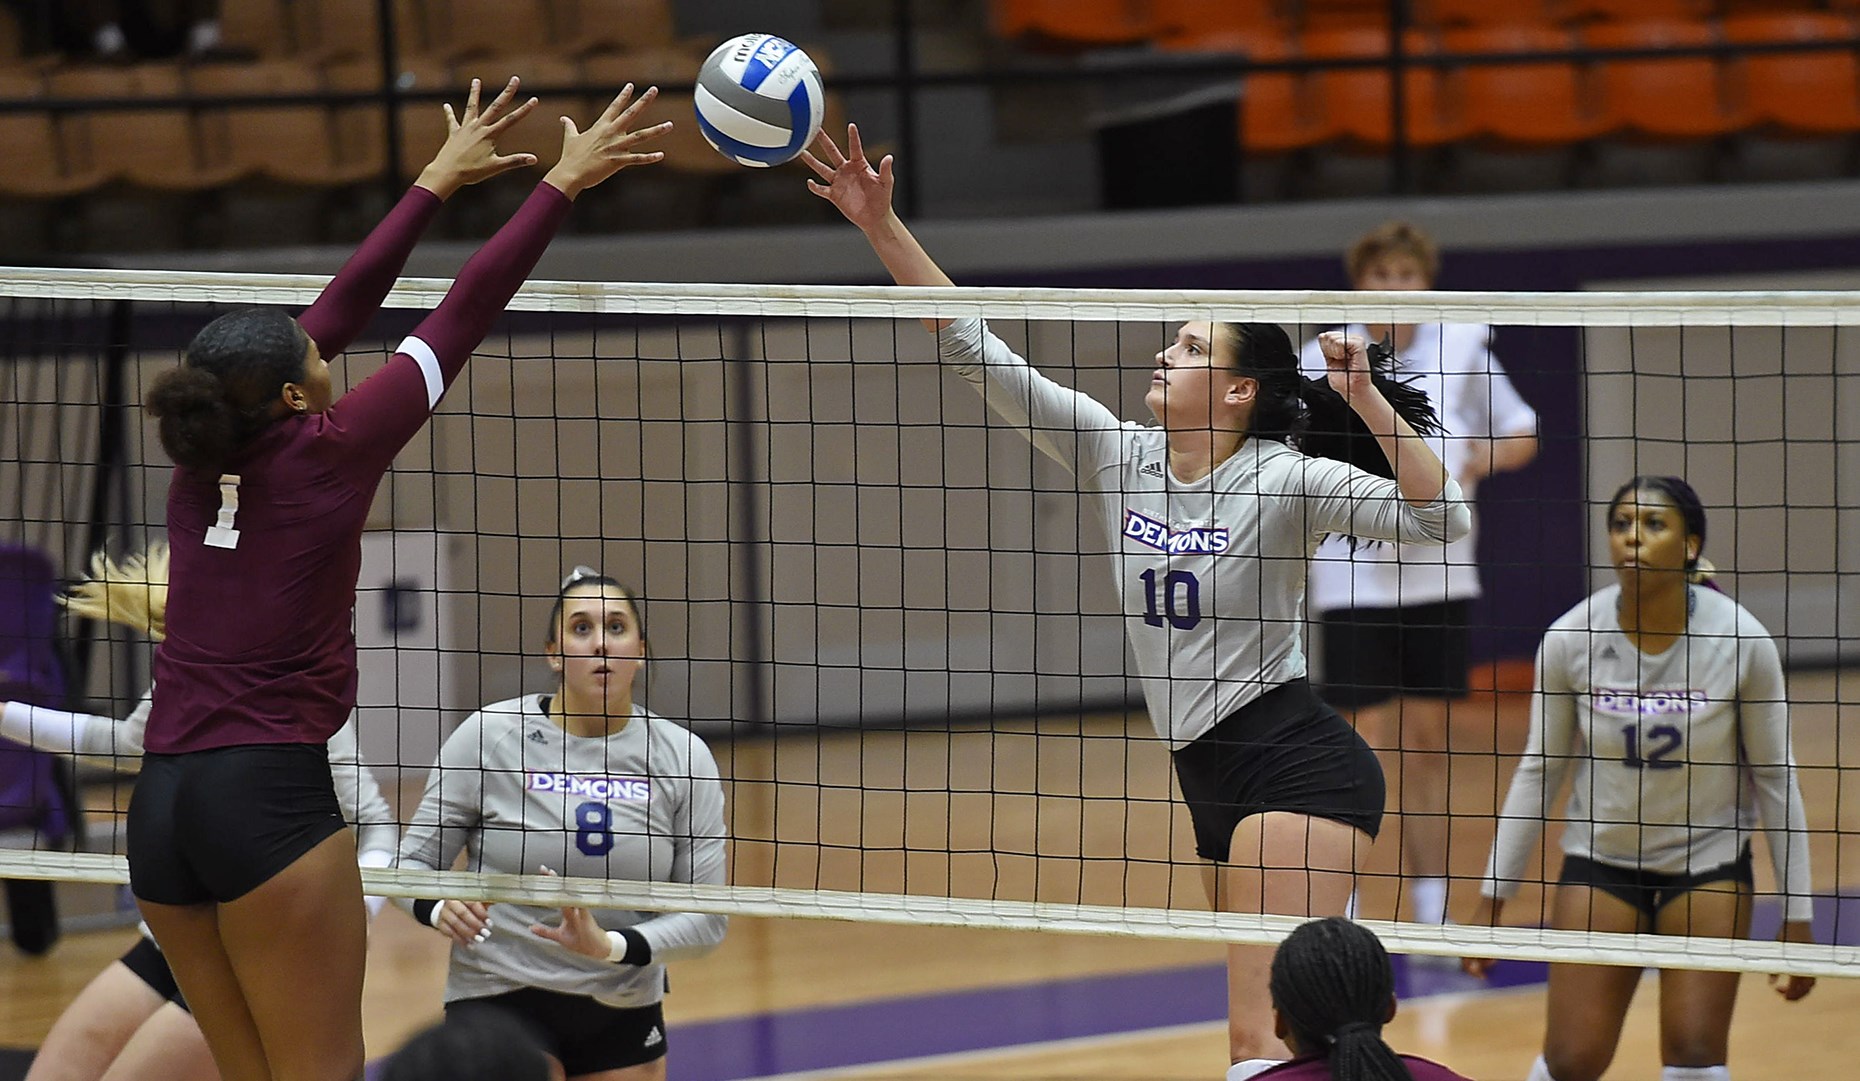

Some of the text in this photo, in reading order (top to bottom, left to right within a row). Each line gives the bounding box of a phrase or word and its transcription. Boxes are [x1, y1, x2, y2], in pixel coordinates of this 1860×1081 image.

[203, 474, 241, 549] 1
[1125, 513, 1228, 554] DEMONS
[1139, 568, 1201, 630] 10
[1598, 687, 1706, 714] DEMONS
[1622, 725, 1684, 769] 12
[531, 772, 650, 801] DEMONS
[575, 801, 614, 857] 8
